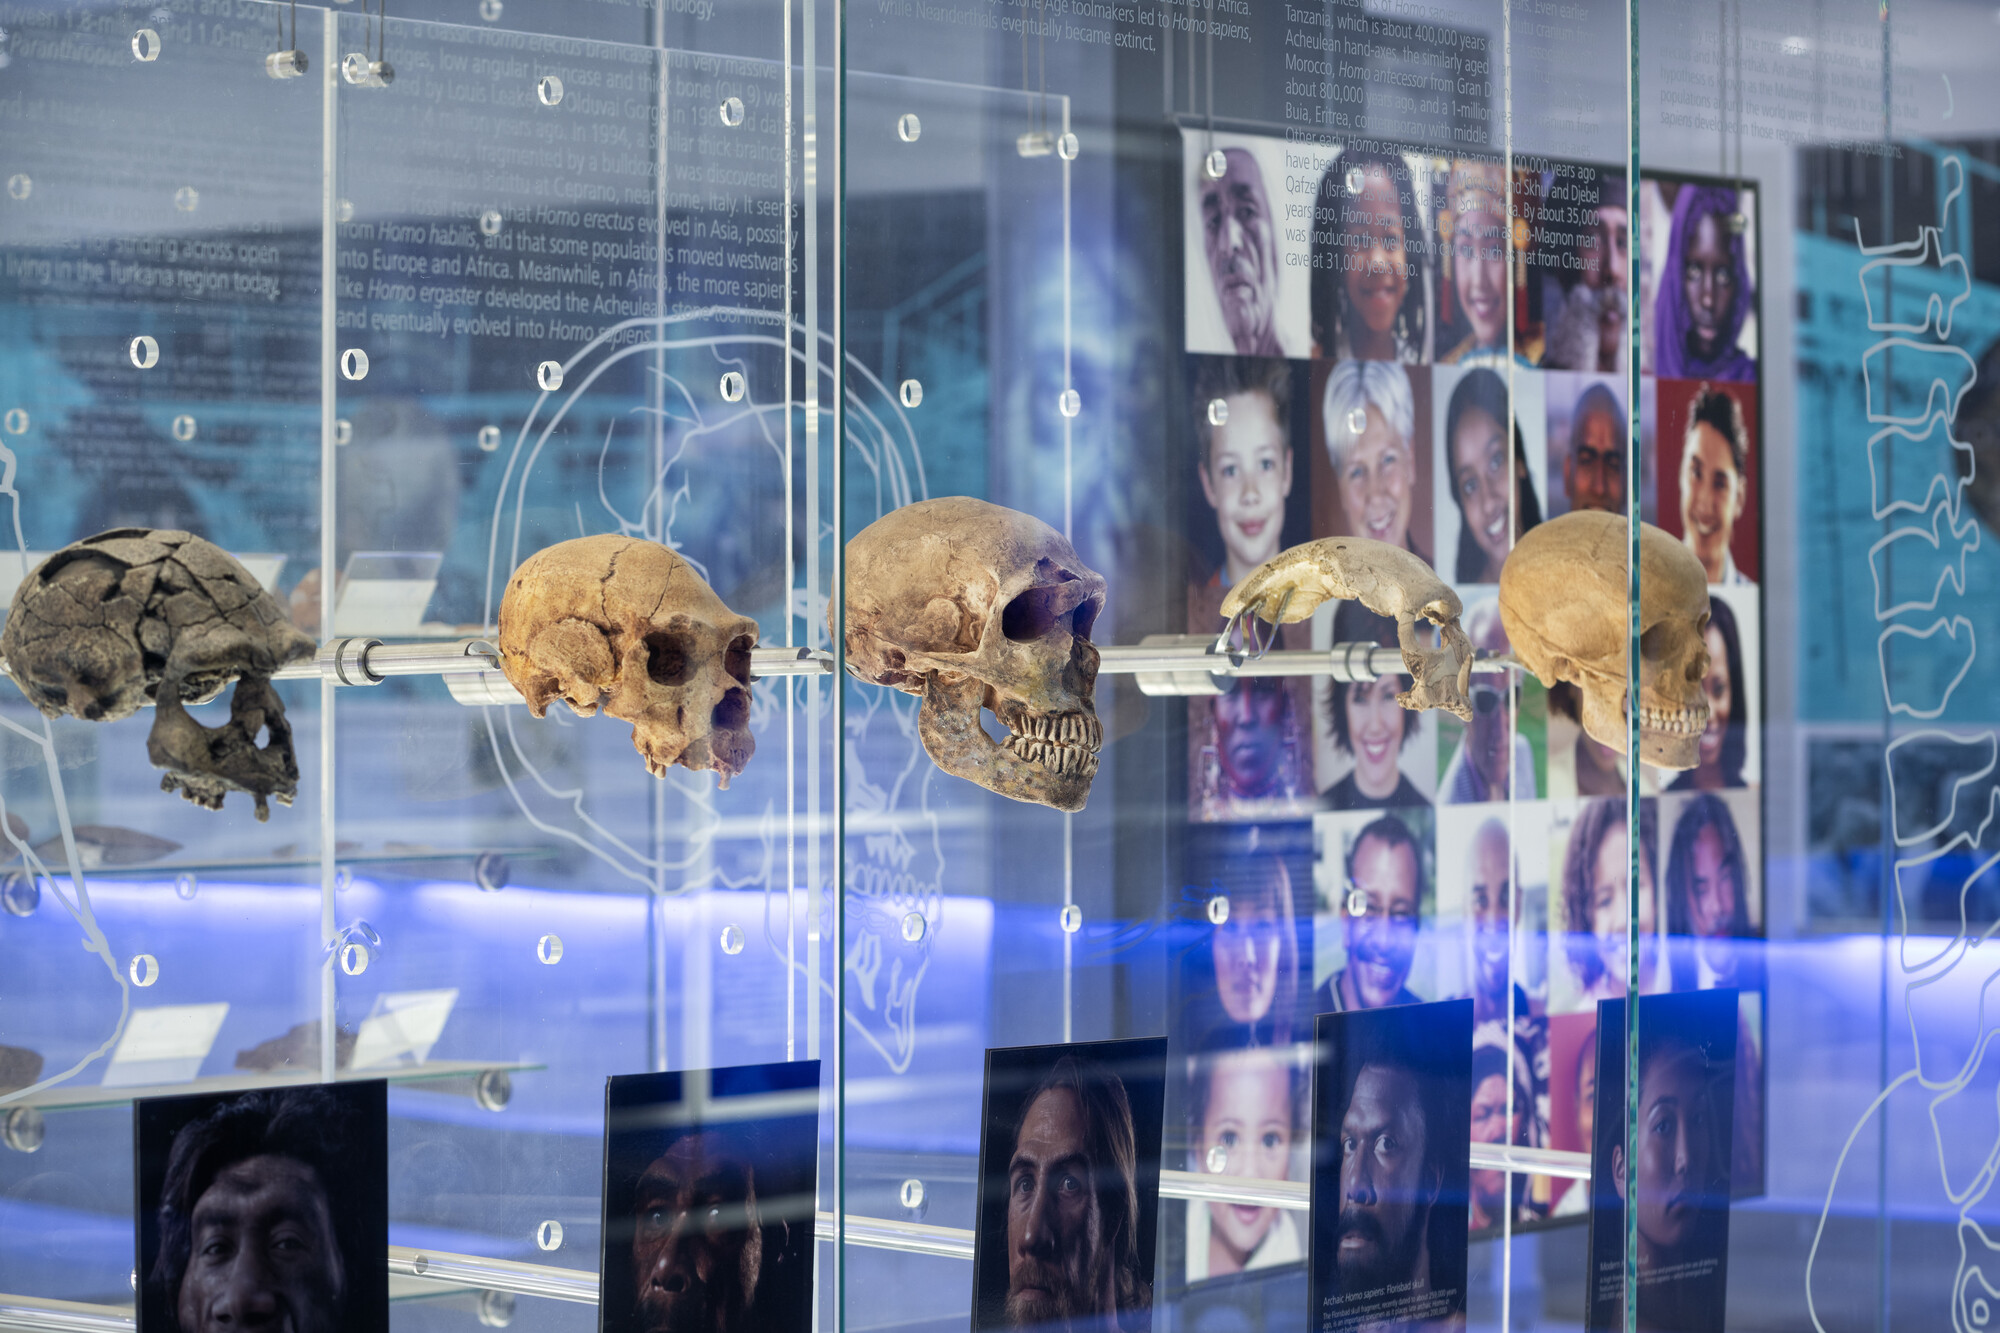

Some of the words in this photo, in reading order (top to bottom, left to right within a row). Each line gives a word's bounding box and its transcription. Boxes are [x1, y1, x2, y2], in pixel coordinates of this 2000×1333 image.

[915, 1, 998, 29] Neanderthals
[1001, 17, 1062, 43] eventually
[1065, 22, 1109, 44] became
[1114, 31, 1155, 51] extinct.
[1071, 0, 1134, 23] toolmakers
[1137, 7, 1154, 26] led
[1157, 12, 1169, 28] to
[1172, 13, 1206, 33] Homo
[1209, 20, 1252, 42] sapiens,
[1284, 4, 1333, 30] Tanzania,
[1336, 12, 1368, 32] which
[1371, 17, 1379, 34] is
[1381, 19, 1412, 39] about
[1414, 24, 1457, 46] 400,000
[1459, 34, 1485, 51] years
[1284, 29, 1340, 52] Acheulean
[1344, 36, 1399, 64] hand-axes,
[1402, 45, 1419, 63] the
[1422, 49, 1461, 74] similarly
[1464, 57, 1489, 76] aged
[606, 70, 633, 90] and
[676, 77, 711, 99] bone
[1285, 53, 1334, 78] Morocco,
[1338, 61, 1369, 80] Homo
[1373, 68, 1427, 88] antecessor
[1430, 72, 1454, 92] from
[1456, 77, 1481, 96] Gran
[1285, 77, 1316, 97] about
[1319, 82, 1363, 104] 800,000
[1365, 92, 1394, 109] years
[1395, 96, 1417, 114] ago,
[1419, 96, 1439, 113] and
[1451, 100, 1493, 120] 1-million
[1285, 102, 1311, 124] Buia,
[1315, 106, 1351, 129] Eritrea,
[1354, 114, 1425, 140] contemporary
[1428, 121, 1450, 138] with
[1453, 124, 1487, 143] middle
[1285, 126, 1318, 146] Other
[1320, 131, 1344, 154] early
[1347, 134, 1379, 153] Homo
[1381, 140, 1419, 160] sapiens
[1422, 142, 1453, 167] dating
[1470, 152, 1505, 168] around
[1550, 163, 1575, 179] years
[1577, 166, 1595, 183] ago
[1285, 149, 1309, 169] have
[1312, 153, 1338, 172] been
[1341, 156, 1370, 176] found
[1386, 163, 1416, 184] Djebel
[1523, 179, 1548, 197] Skhul
[1550, 183, 1568, 199] and
[1571, 185, 1599, 205] Djebel
[624, 188, 655, 204] near
[708, 192, 738, 217] Italy.
[1285, 175, 1322, 195] Qafzeh
[1377, 186, 1398, 203] well
[1400, 191, 1410, 204] as
[1523, 202, 1535, 223] By
[1536, 203, 1564, 221] about
[1566, 207, 1599, 226] 35,000
[378, 222, 425, 244] Homo
[516, 232, 546, 252] that
[549, 239, 588, 255] some
[592, 240, 674, 264] populations
[677, 247, 723, 265] moved
[535, 205, 579, 226] Homo
[583, 213, 634, 231] erectus
[693, 218, 705, 236] in
[710, 220, 741, 243] Asia,
[1285, 203, 1311, 221] years
[1315, 206, 1337, 224] ago,
[1340, 205, 1372, 224] Homo
[1375, 210, 1411, 231] sapiens
[1513, 224, 1573, 248] Cro-Magnon
[1575, 234, 1599, 251] man,
[1285, 227, 1306, 241] was
[1310, 227, 1359, 252] producing
[1361, 231, 1377, 248] the
[1403, 235, 1436, 254] known
[1481, 244, 1502, 261] such
[1537, 249, 1559, 266] from
[1561, 252, 1599, 270] Chauvet
[1285, 252, 1309, 266] cave
[1312, 252, 1323, 267] at
[1326, 252, 1363, 272] 31,000
[1366, 259, 1393, 277] years
[1395, 262, 1418, 280] ago.
[373, 251, 428, 279] Europe
[431, 255, 461, 275] and
[465, 257, 513, 279] Africa.
[519, 261, 604, 289] Meanwhile,
[608, 267, 622, 286] in
[676, 272, 699, 291] the
[704, 278, 739, 294] more
[367, 280, 416, 302] Homo
[419, 288, 481, 310] ergaster
[484, 287, 561, 316] developed
[564, 292, 589, 312] the
[593, 295, 668, 317] Acheulean
[371, 312, 449, 339] eventually
[453, 315, 511, 336] evolved
[514, 318, 545, 338] into
[548, 321, 594, 341] Homo
[1323, 1296, 1343, 1306] Archaic
[1345, 1291, 1362, 1302] Homo
[1412, 1278, 1425, 1289] skull
